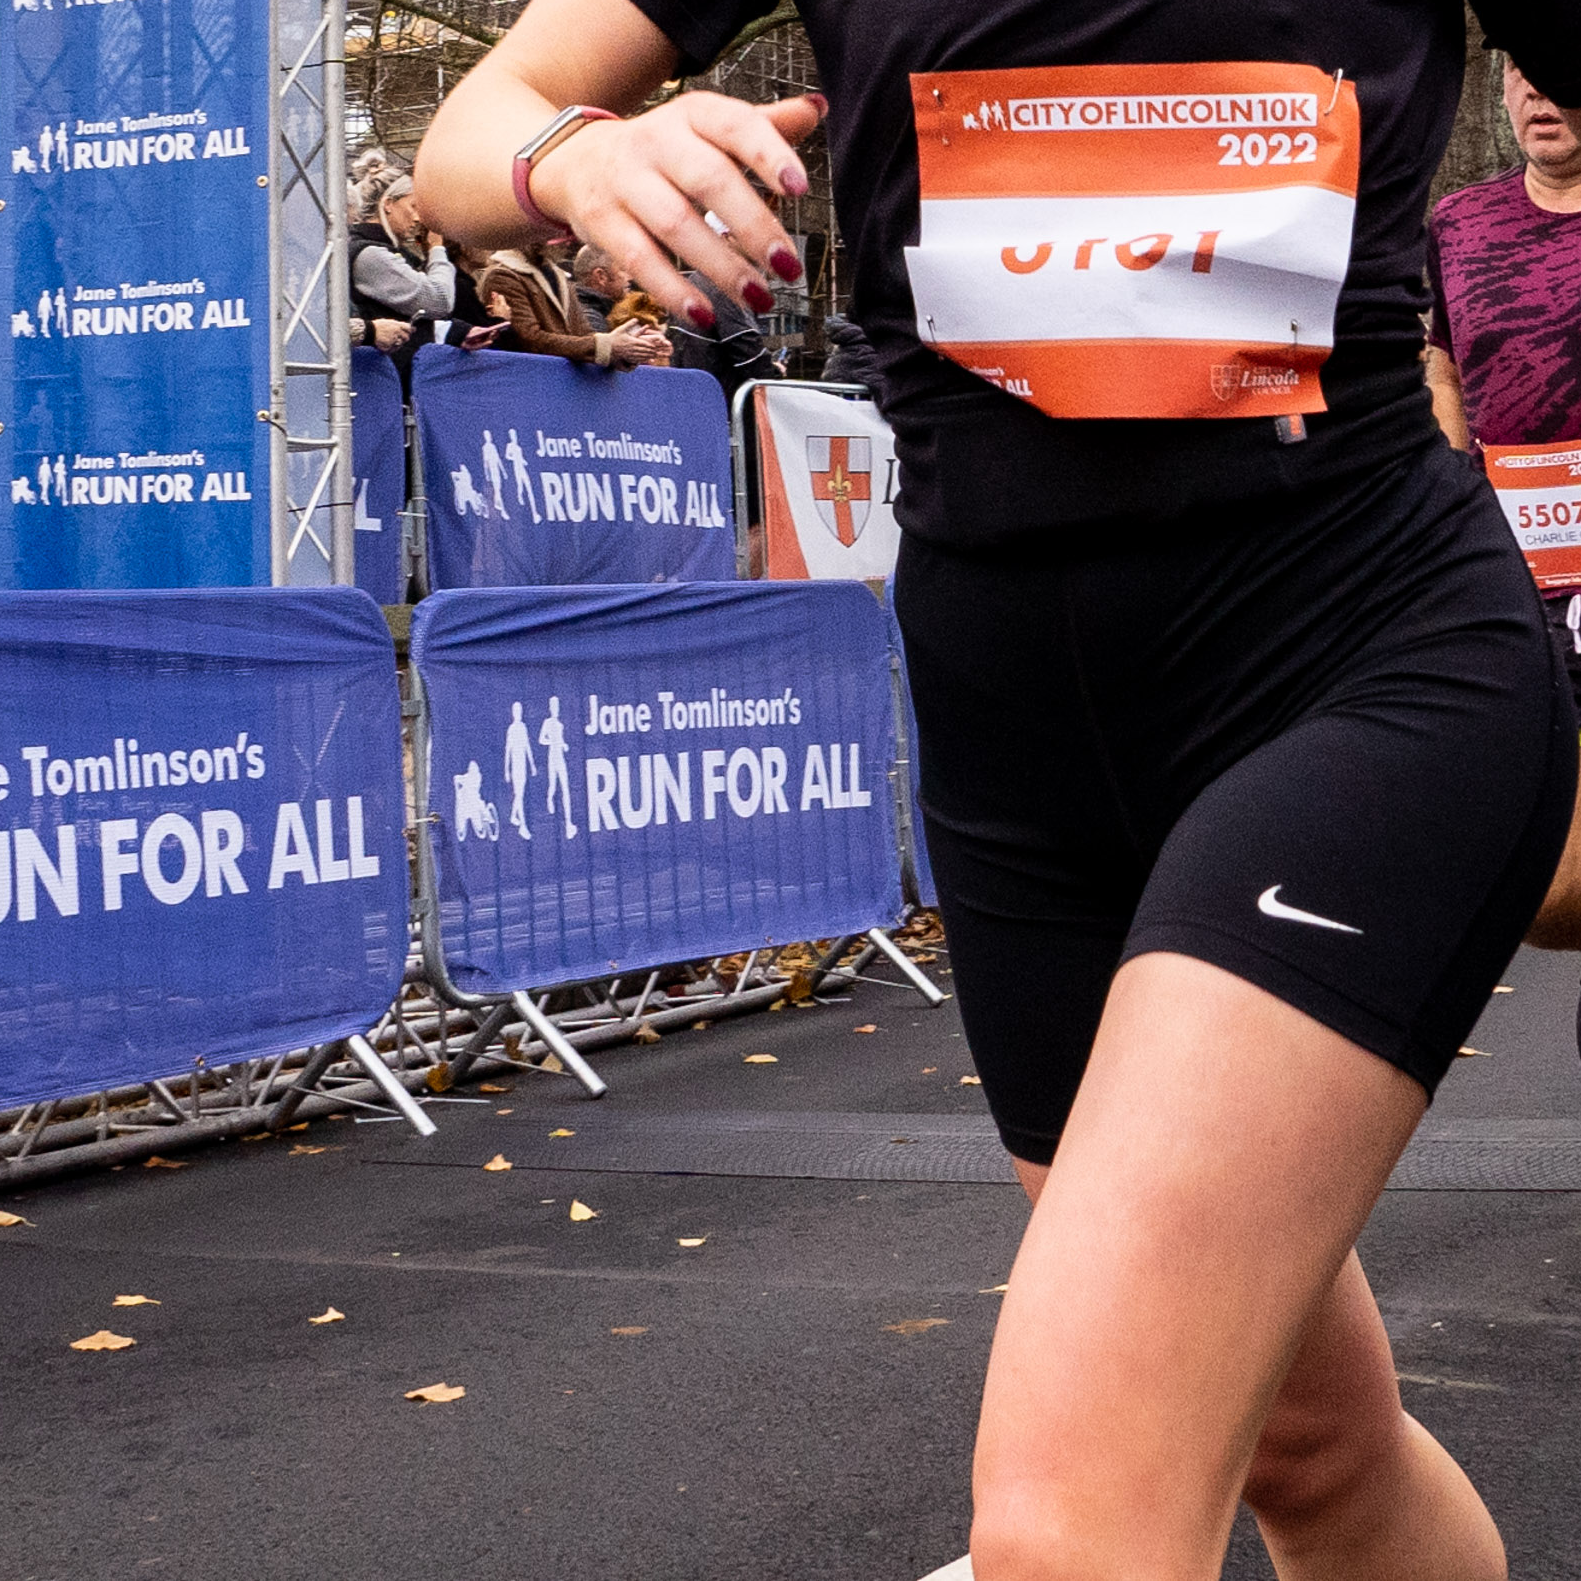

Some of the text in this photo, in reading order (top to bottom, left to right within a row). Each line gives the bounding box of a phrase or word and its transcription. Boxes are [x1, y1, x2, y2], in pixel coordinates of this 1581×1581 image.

[75, 110, 207, 135] Jane Tomlinson's
[1014, 99, 1311, 126] CITY OF LINCOLN 10K
[74, 127, 250, 170] RUN FOR ALL
[1218, 133, 1317, 166] 2022
[73, 278, 205, 302] Jane Tomlinson's
[72, 299, 250, 336] RUN FOR ALL
[73, 450, 205, 469] Jane Tomlinson's
[536, 430, 682, 465] Jane Tomlinson's
[71, 472, 252, 506] RUN FOR ALL
[541, 472, 725, 529] RUN FOR ALL
[1525, 531, 1577, 546] CHARLIE
[585, 688, 801, 735] Jane Tomlinson's
[22, 732, 265, 798] Tomlinson's
[586, 743, 871, 833] RUN FOR ALL
[100, 808, 248, 909] FOR
[268, 796, 379, 889] ALL
